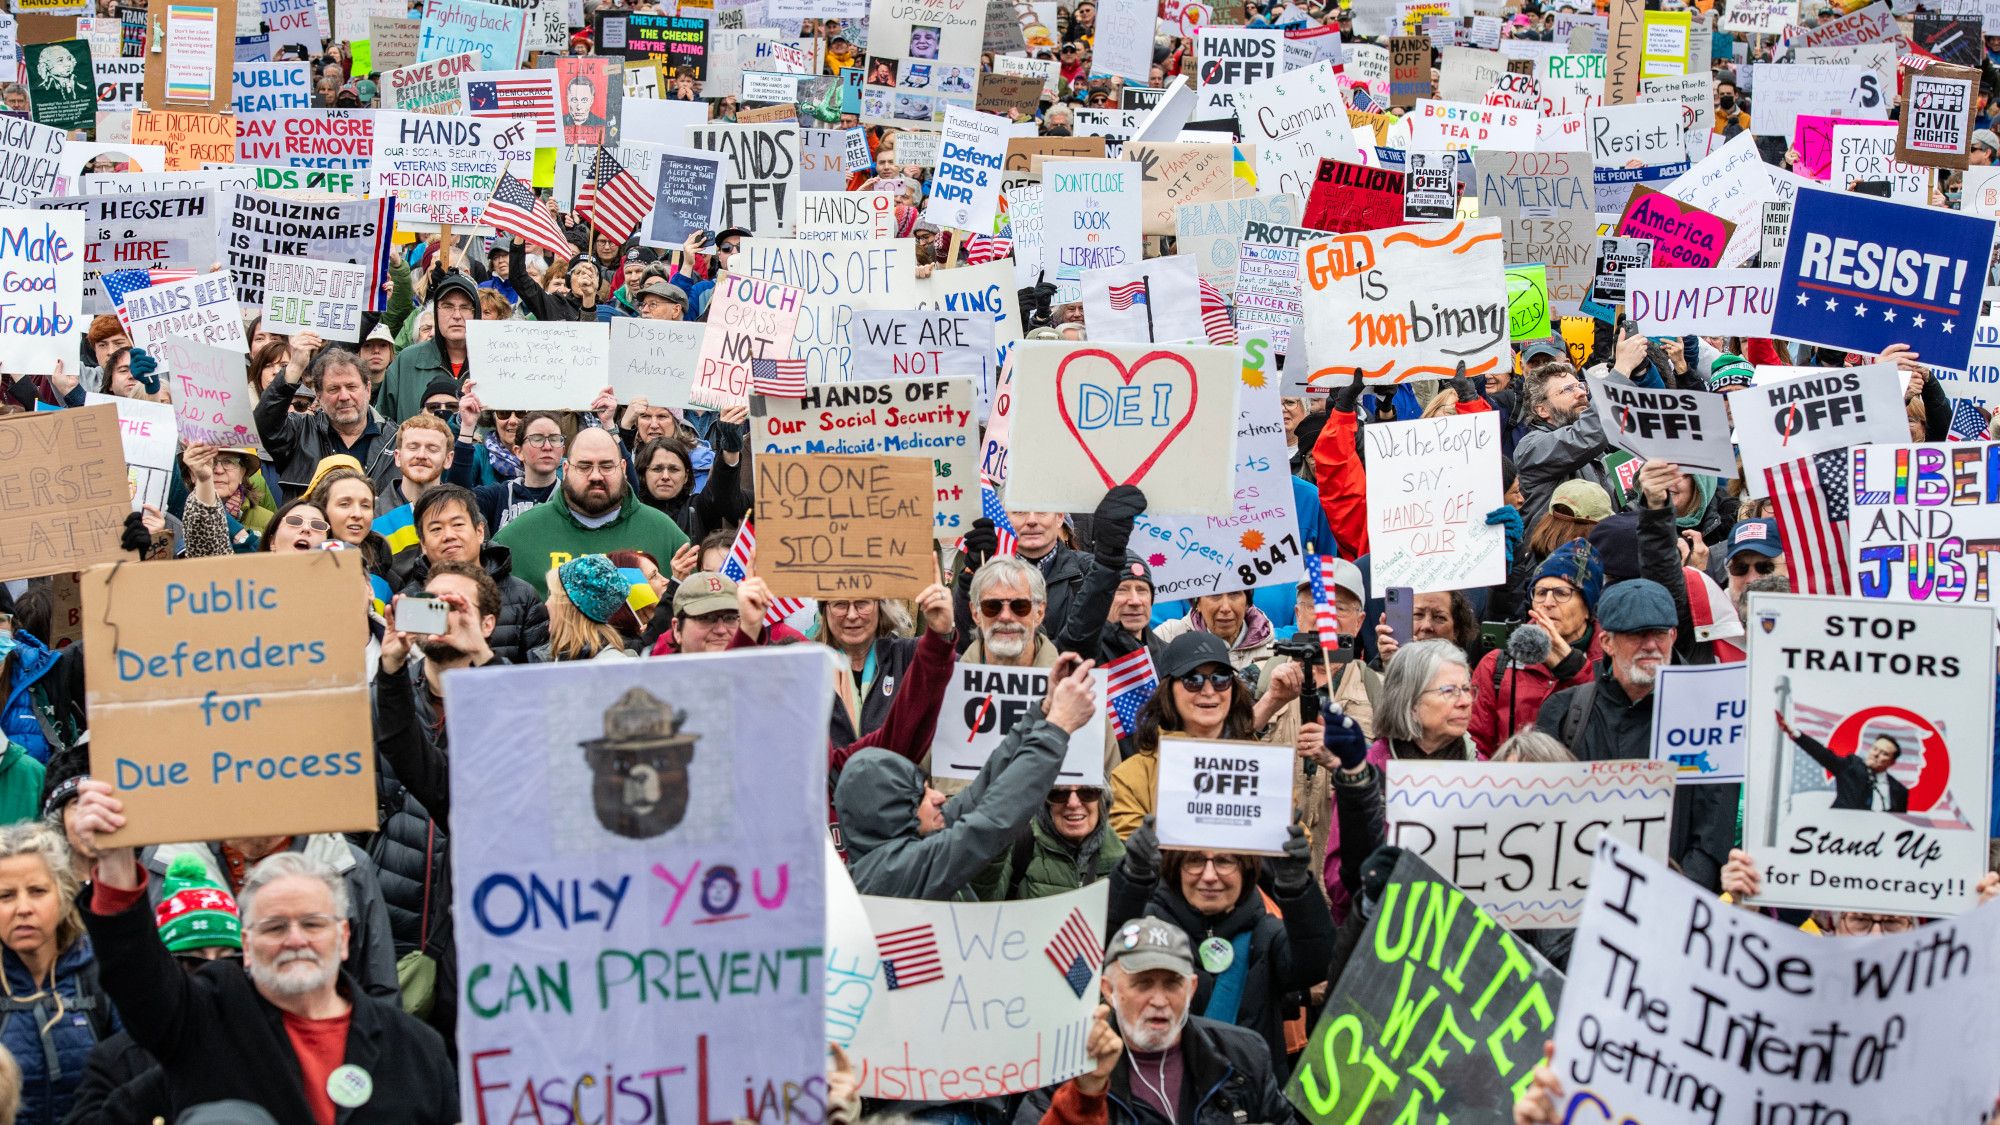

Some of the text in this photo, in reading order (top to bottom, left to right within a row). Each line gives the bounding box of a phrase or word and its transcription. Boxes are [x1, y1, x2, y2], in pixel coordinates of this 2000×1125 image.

[269, 11, 312, 32] LOVE
[480, 13, 513, 32] back
[629, 15, 668, 27] THEY'RE
[671, 18, 704, 29] EATING
[718, 10, 743, 25] HANDS
[1806, 12, 1874, 48] AMERICA
[640, 29, 704, 43] THE CHECKS!
[1390, 39, 1430, 52] HANDS
[1857, 24, 1881, 43] ON
[628, 40, 704, 55] THEY'RE EATING
[1203, 37, 1276, 58] HANDS
[1394, 53, 1421, 66] OFF
[578, 63, 595, 75] AM
[1026, 62, 1050, 72] NOT
[1394, 68, 1420, 79] DUE
[499, 87, 550, 97] DEMOCRACY
[1390, 83, 1431, 95] PROCESS
[1644, 82, 1662, 94] For
[1917, 82, 1963, 95] HANDS
[326, 110, 350, 118] WAS
[1916, 92, 1963, 112] OFF!
[166, 115, 231, 137] DICTATOR
[511, 111, 539, 119] EMPTY
[1076, 111, 1110, 125] This
[1258, 101, 1336, 140] Conman
[1425, 105, 1518, 127] BOSTON IS
[1563, 120, 1581, 134] UP
[1915, 112, 1959, 131] CIVIL
[168, 133, 186, 142] AND
[401, 119, 526, 150] HANDS OFF
[1913, 129, 1959, 143] RIGHTS
[190, 143, 235, 163] FASCISTS
[412, 148, 532, 161] SOCIAL JOBS
[942, 142, 1004, 170] Defend
[1506, 151, 1570, 176] 2025
[1842, 156, 1881, 173] FOR
[451, 162, 497, 173] SERVICES
[939, 162, 973, 183] PBS
[1416, 168, 1448, 176] HANDS
[1608, 165, 1687, 180] PEOPLE ACLU
[935, 182, 973, 205] NPR
[1416, 176, 1448, 188] OFF!
[1484, 173, 1589, 210] AMERICA
[101, 197, 205, 220] HEGSETH
[234, 193, 340, 220] IDOLIZING
[804, 196, 870, 225] HANDS
[231, 211, 375, 240] BILLIONAIRES
[1073, 210, 1111, 230] BOOK
[1510, 219, 1573, 244] 1938
[1631, 198, 1715, 252] America
[1, 222, 73, 264] Make
[98, 227, 111, 239] is
[230, 232, 308, 256] IS LIKE
[800, 230, 869, 241] DEPORT MUSK
[1087, 233, 1100, 242] on
[115, 241, 171, 262] HIRE
[1060, 245, 1126, 269] LIBRARIES
[1306, 234, 1375, 292] GOD
[1606, 254, 1641, 263] HANDS
[3, 268, 56, 294] Good
[268, 262, 365, 299] HANDS OFF
[846, 249, 898, 294] OFF
[1799, 232, 1968, 306] RESIST!
[127, 286, 192, 319] HANDS
[726, 275, 798, 312] TOUCH
[945, 284, 1004, 314] KING
[1236, 294, 1284, 310] CANCER
[0, 300, 73, 337] Trouble
[147, 309, 221, 341] MEDICAL
[316, 303, 359, 331] SEC
[1348, 299, 1506, 351] non-binary
[627, 322, 696, 349] Disobey
[864, 317, 970, 347] WE ARE
[570, 343, 593, 353] and
[721, 332, 774, 365] NOT
[572, 356, 600, 366] NOT
[627, 358, 686, 380] Advance
[893, 352, 943, 375] NOT
[177, 374, 232, 405] Trump
[801, 381, 949, 411] HANDS OFF
[1603, 384, 1699, 411] HANDS
[1768, 373, 1860, 407] HANDS
[767, 404, 971, 436] Our Social Security
[1610, 404, 1704, 441] OFF!
[1774, 394, 1867, 438] OFF!
[760, 462, 895, 498] NO ONE
[794, 495, 924, 519] ILLEGAL
[1206, 505, 1287, 529] Museums
[1383, 490, 1475, 529] HANDS OFF
[829, 519, 848, 534] ON
[1862, 508, 1953, 542] AND
[775, 535, 907, 566] STOLEN
[1175, 526, 1235, 571] Speech
[1411, 529, 1456, 553] OUR
[1238, 533, 1300, 586] 8647
[816, 573, 873, 592] LAND
[165, 578, 278, 616] Public
[1825, 616, 1917, 641] STOP
[116, 636, 327, 682] Defenders
[1782, 648, 1961, 679] TRAITORS
[200, 691, 262, 726] for
[1667, 727, 1722, 747] OUR
[115, 750, 363, 791] Due Process
[1193, 756, 1259, 773] HANDS
[1193, 771, 1259, 797] OFF!
[1187, 801, 1262, 818] OUR BODIES
[1394, 811, 1667, 893] RESIST
[1788, 826, 1943, 868] Stand Up
[1766, 865, 1966, 896] for Democracy!!
[472, 860, 790, 936] ONLY YOU
[949, 902, 1030, 961] We
[1683, 897, 1972, 1001] Rise with
[466, 960, 573, 1020] CAN
[596, 945, 825, 1010] PREVENT
[941, 975, 1032, 1034] Are
[1597, 936, 1907, 1086] The Intent of
[1379, 960, 1477, 1104] WE
[471, 1034, 827, 1125] FASCIST LIARS
[1571, 1014, 1725, 1125] getting
